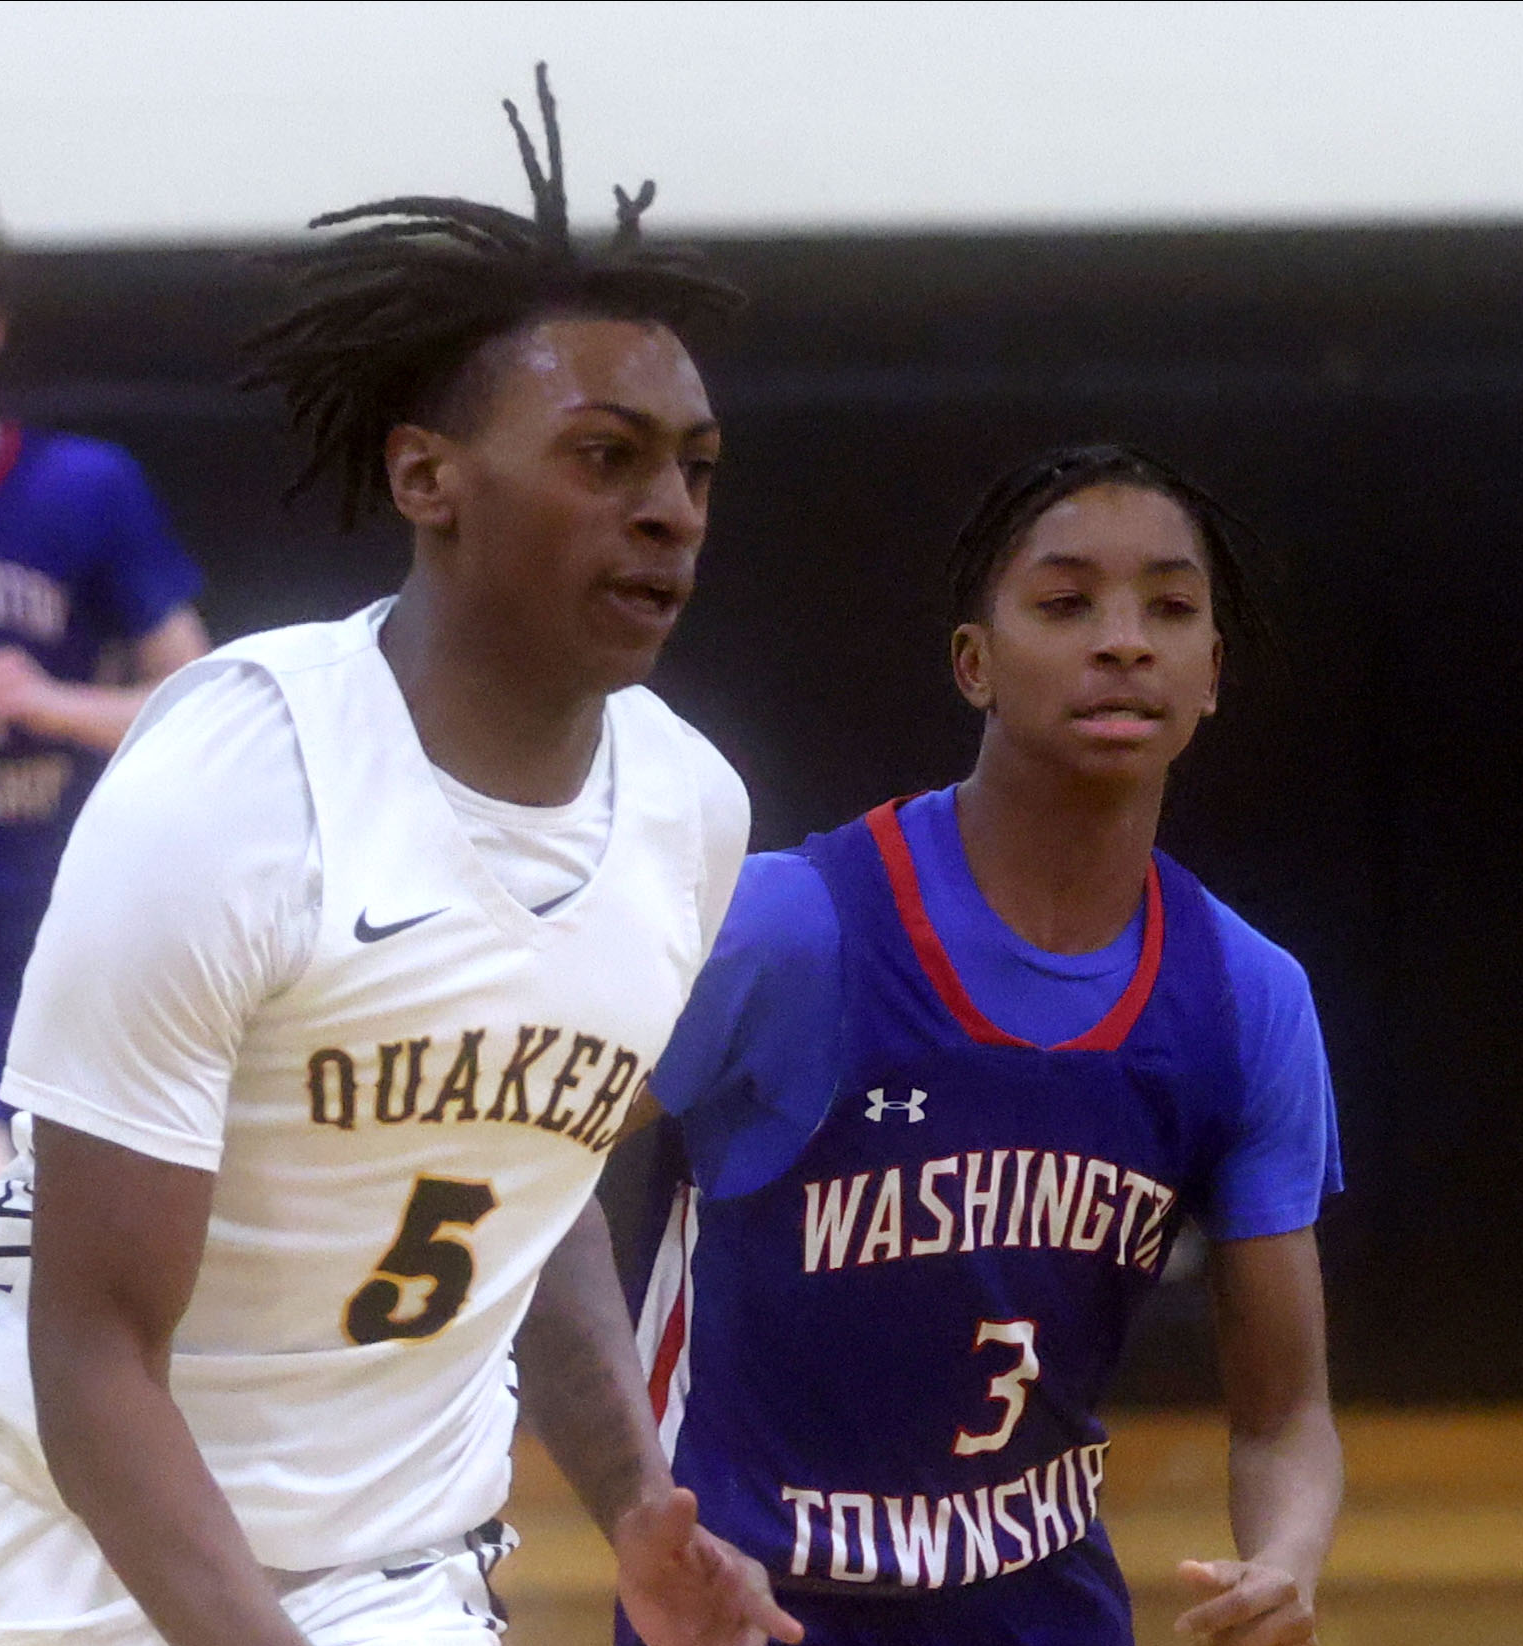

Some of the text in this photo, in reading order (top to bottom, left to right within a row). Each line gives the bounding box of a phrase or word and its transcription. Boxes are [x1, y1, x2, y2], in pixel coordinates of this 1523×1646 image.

[340, 1171, 501, 1346] 5
[953, 1317, 1040, 1457] 3
[781, 1439, 1112, 1589] TOWNSHIP
